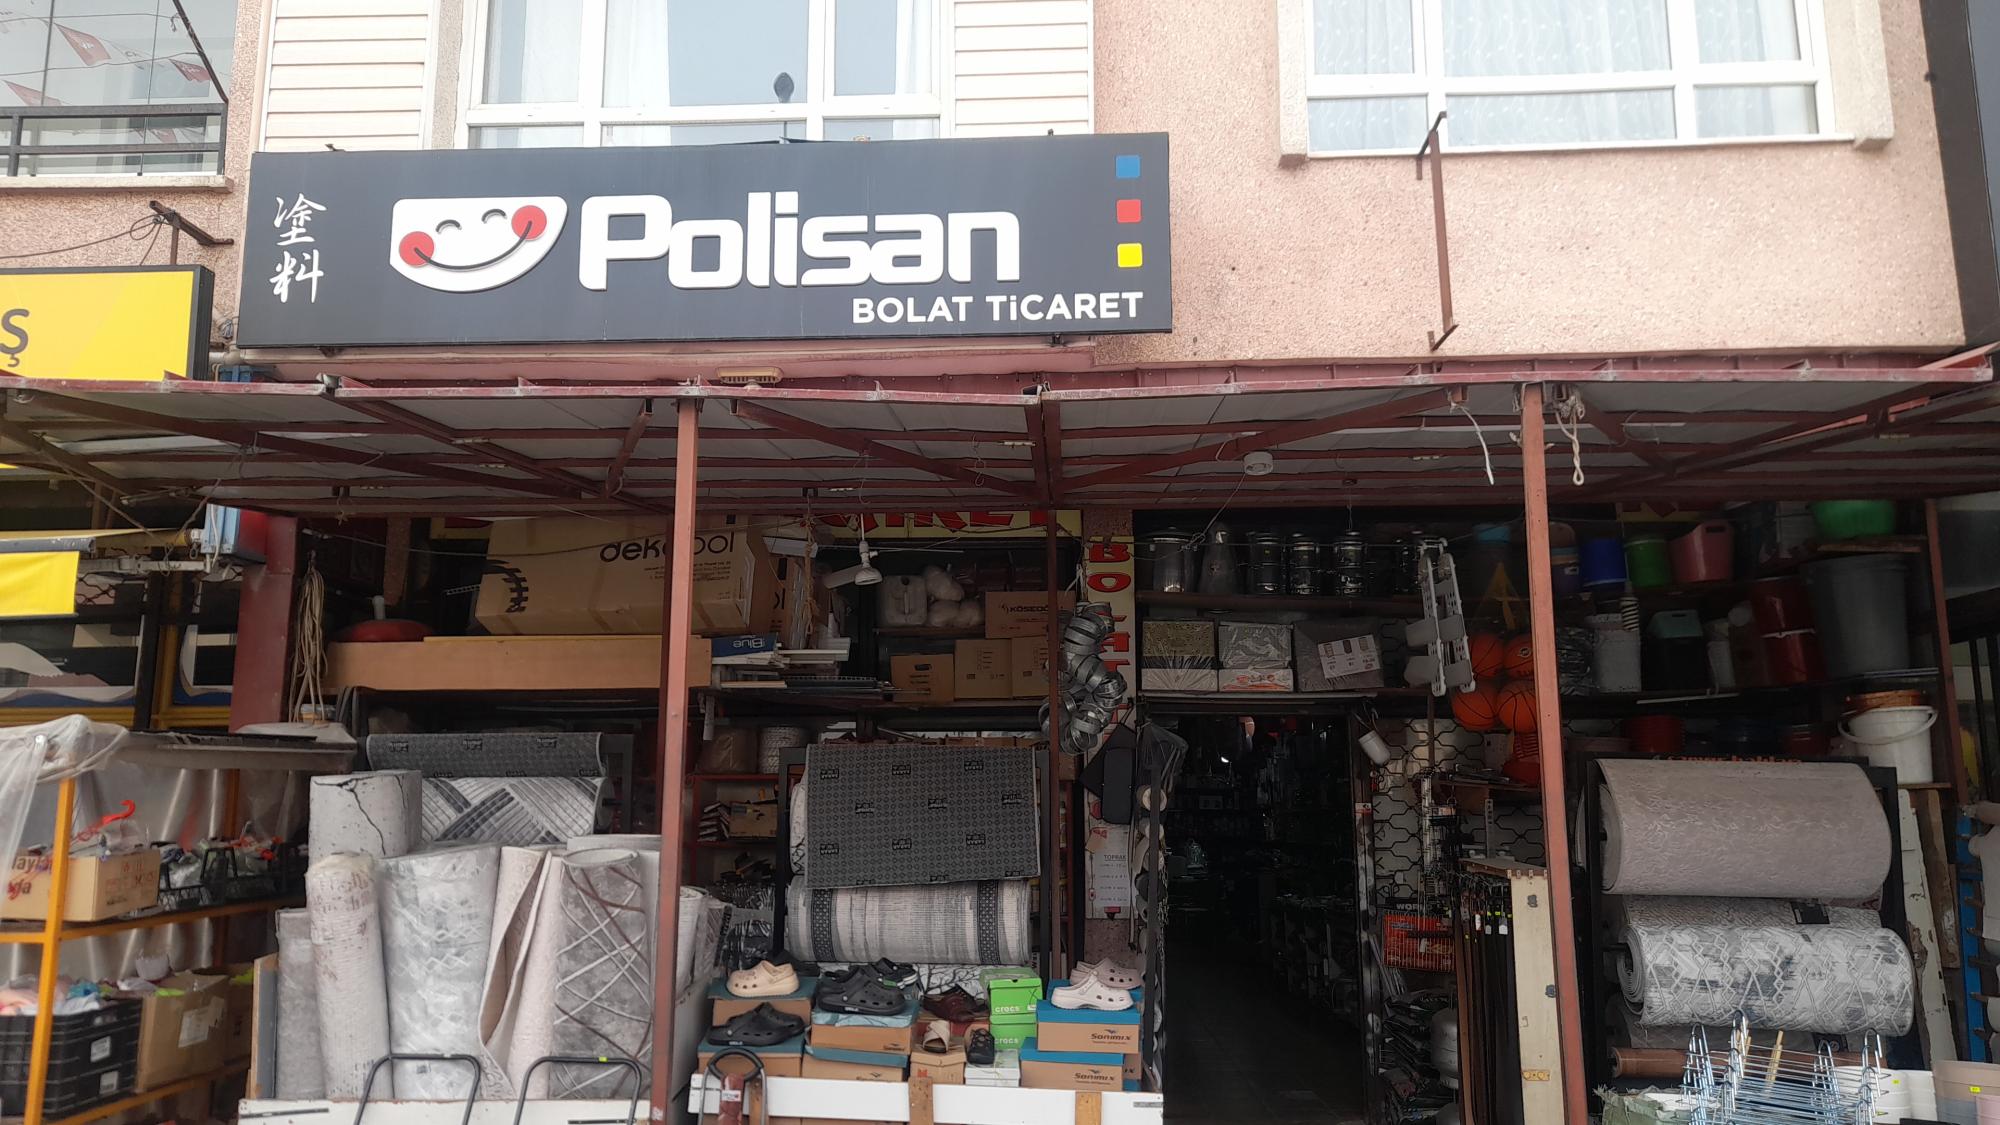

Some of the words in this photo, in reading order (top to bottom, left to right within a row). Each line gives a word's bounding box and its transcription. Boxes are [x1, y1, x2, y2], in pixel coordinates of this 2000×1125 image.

[268, 193, 326, 303] 塗料
[579, 190, 1020, 291] Polisan
[852, 297, 974, 325] BOLAT
[995, 1005, 1020, 1013] crocs
[994, 1037, 1019, 1045] crocs
